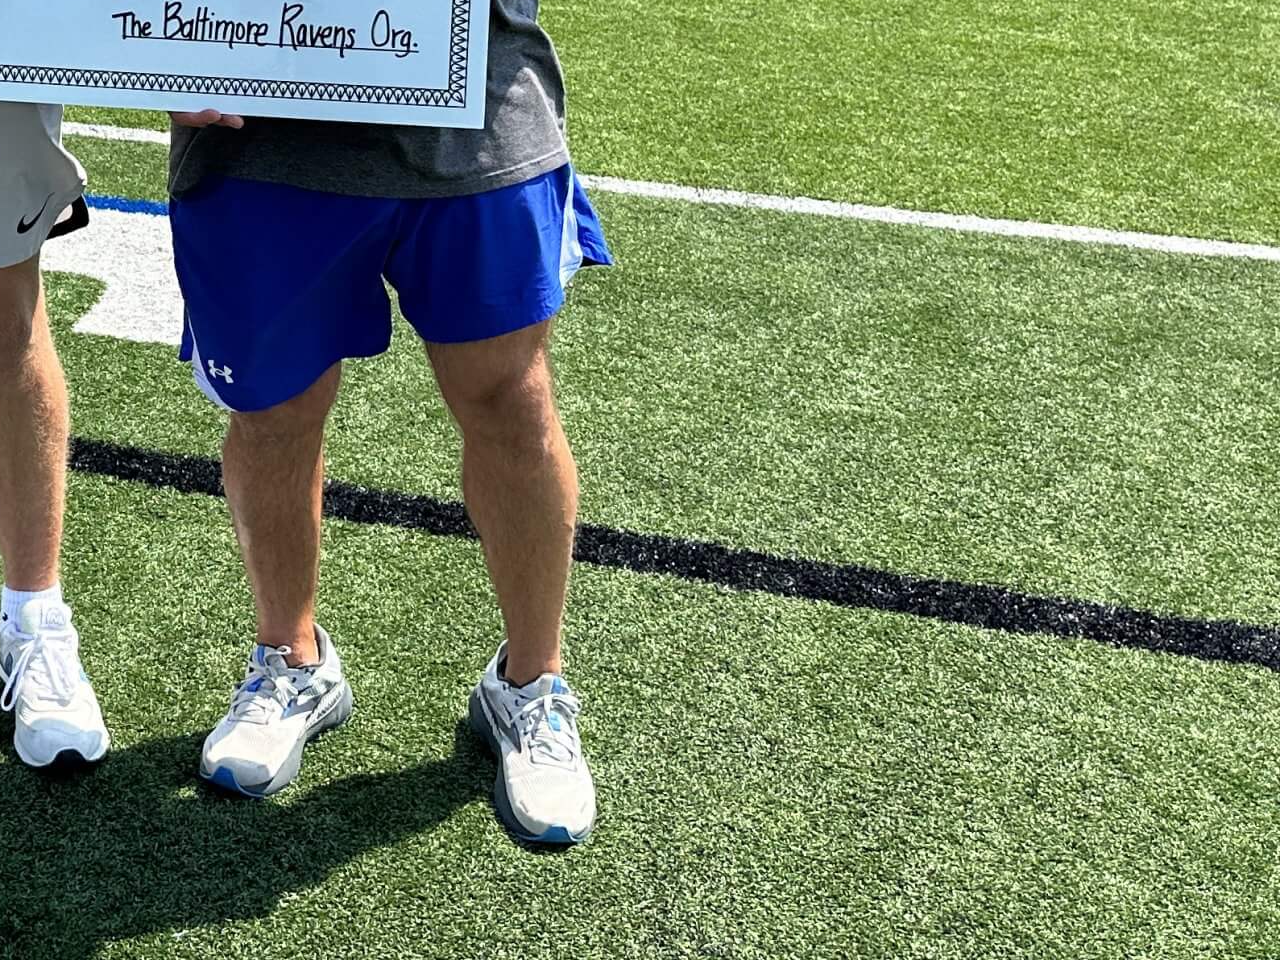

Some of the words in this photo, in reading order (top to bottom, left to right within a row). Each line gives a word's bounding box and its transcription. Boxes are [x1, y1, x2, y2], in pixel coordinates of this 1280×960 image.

[112, 11, 152, 39] The
[164, 1, 268, 48] Baltimore
[280, 2, 356, 57] Ravens
[371, 10, 418, 57] Org.
